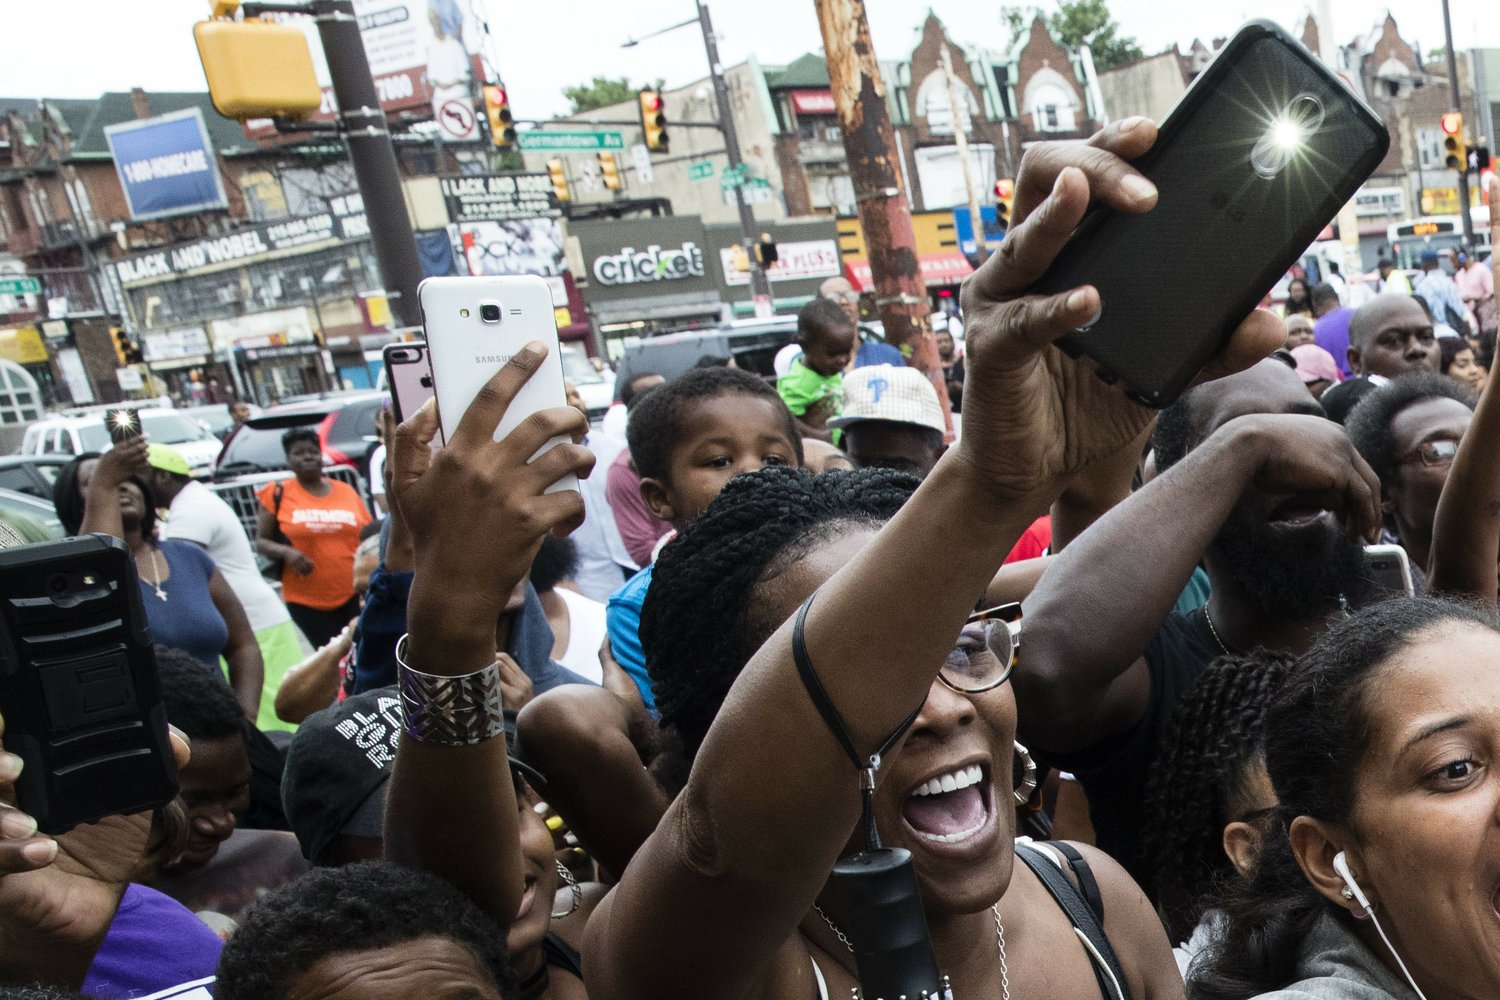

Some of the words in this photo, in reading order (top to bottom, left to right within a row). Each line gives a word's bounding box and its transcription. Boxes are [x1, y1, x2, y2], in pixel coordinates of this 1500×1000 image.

[116, 251, 171, 282] BLACK
[171, 244, 207, 271] AND
[207, 230, 268, 264] NOBEL
[594, 242, 704, 285] cricket
[475, 353, 515, 364] SAMSUN
